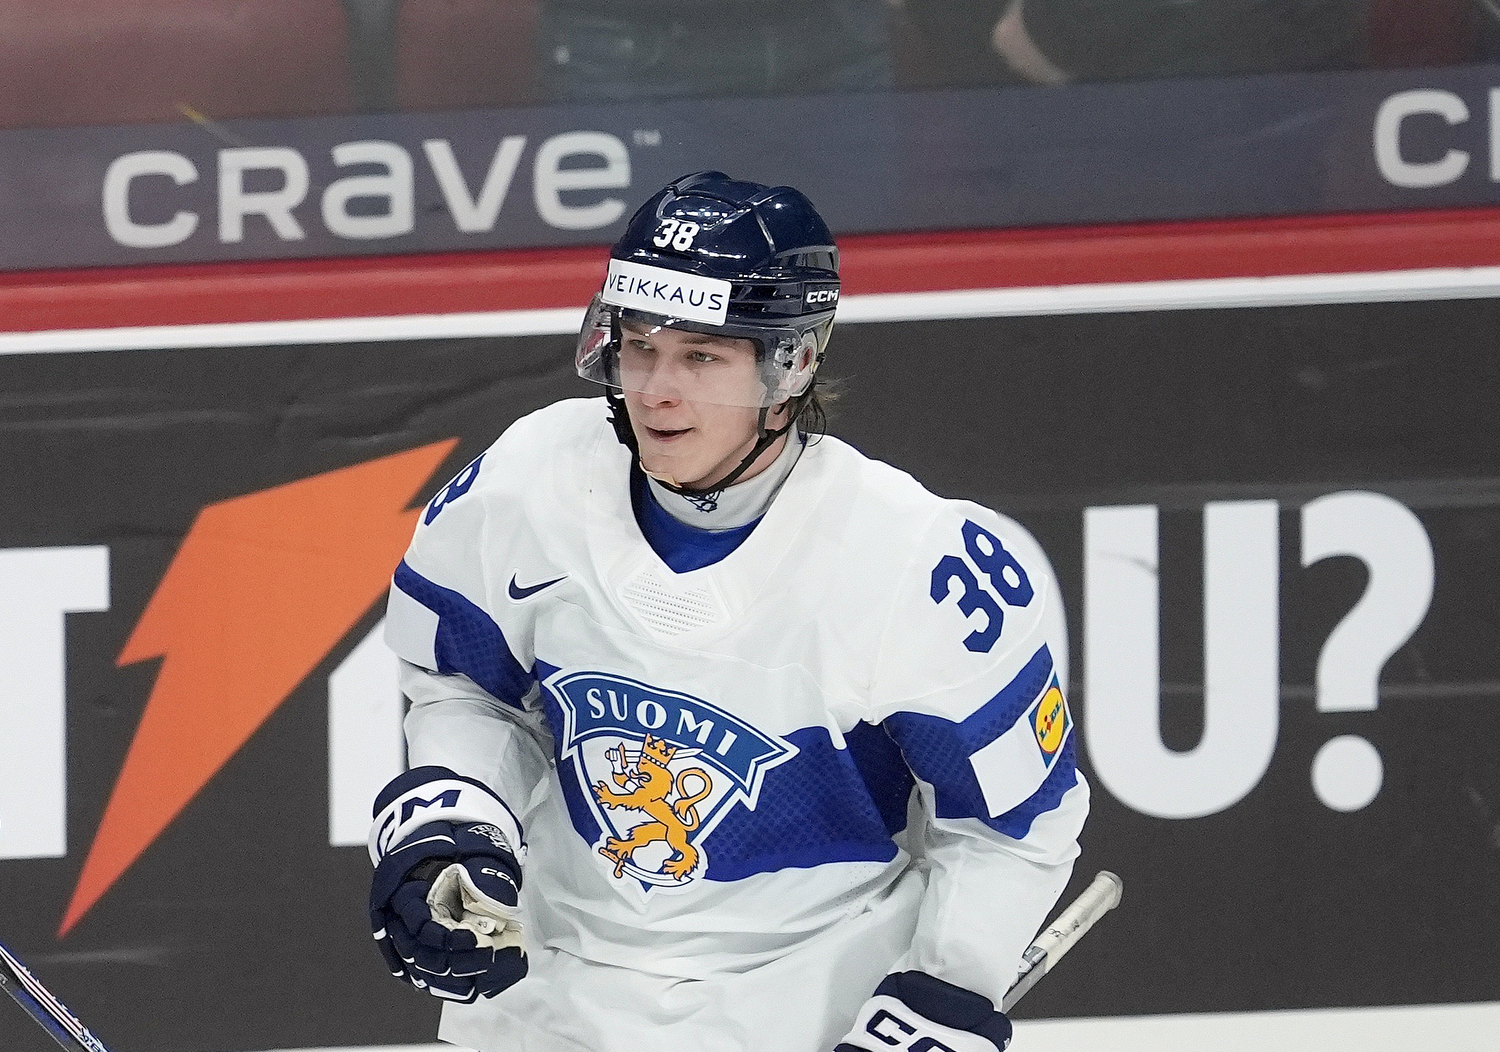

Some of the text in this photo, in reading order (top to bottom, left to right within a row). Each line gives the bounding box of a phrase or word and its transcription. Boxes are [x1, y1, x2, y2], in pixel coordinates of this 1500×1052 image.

[1373, 87, 1500, 189] C
[653, 219, 700, 252] 38
[609, 272, 725, 312] VEIKKAUS
[806, 289, 840, 304] CCM
[423, 452, 487, 527] 8
[929, 518, 1035, 654] 38
[586, 687, 738, 758] SUOMI
